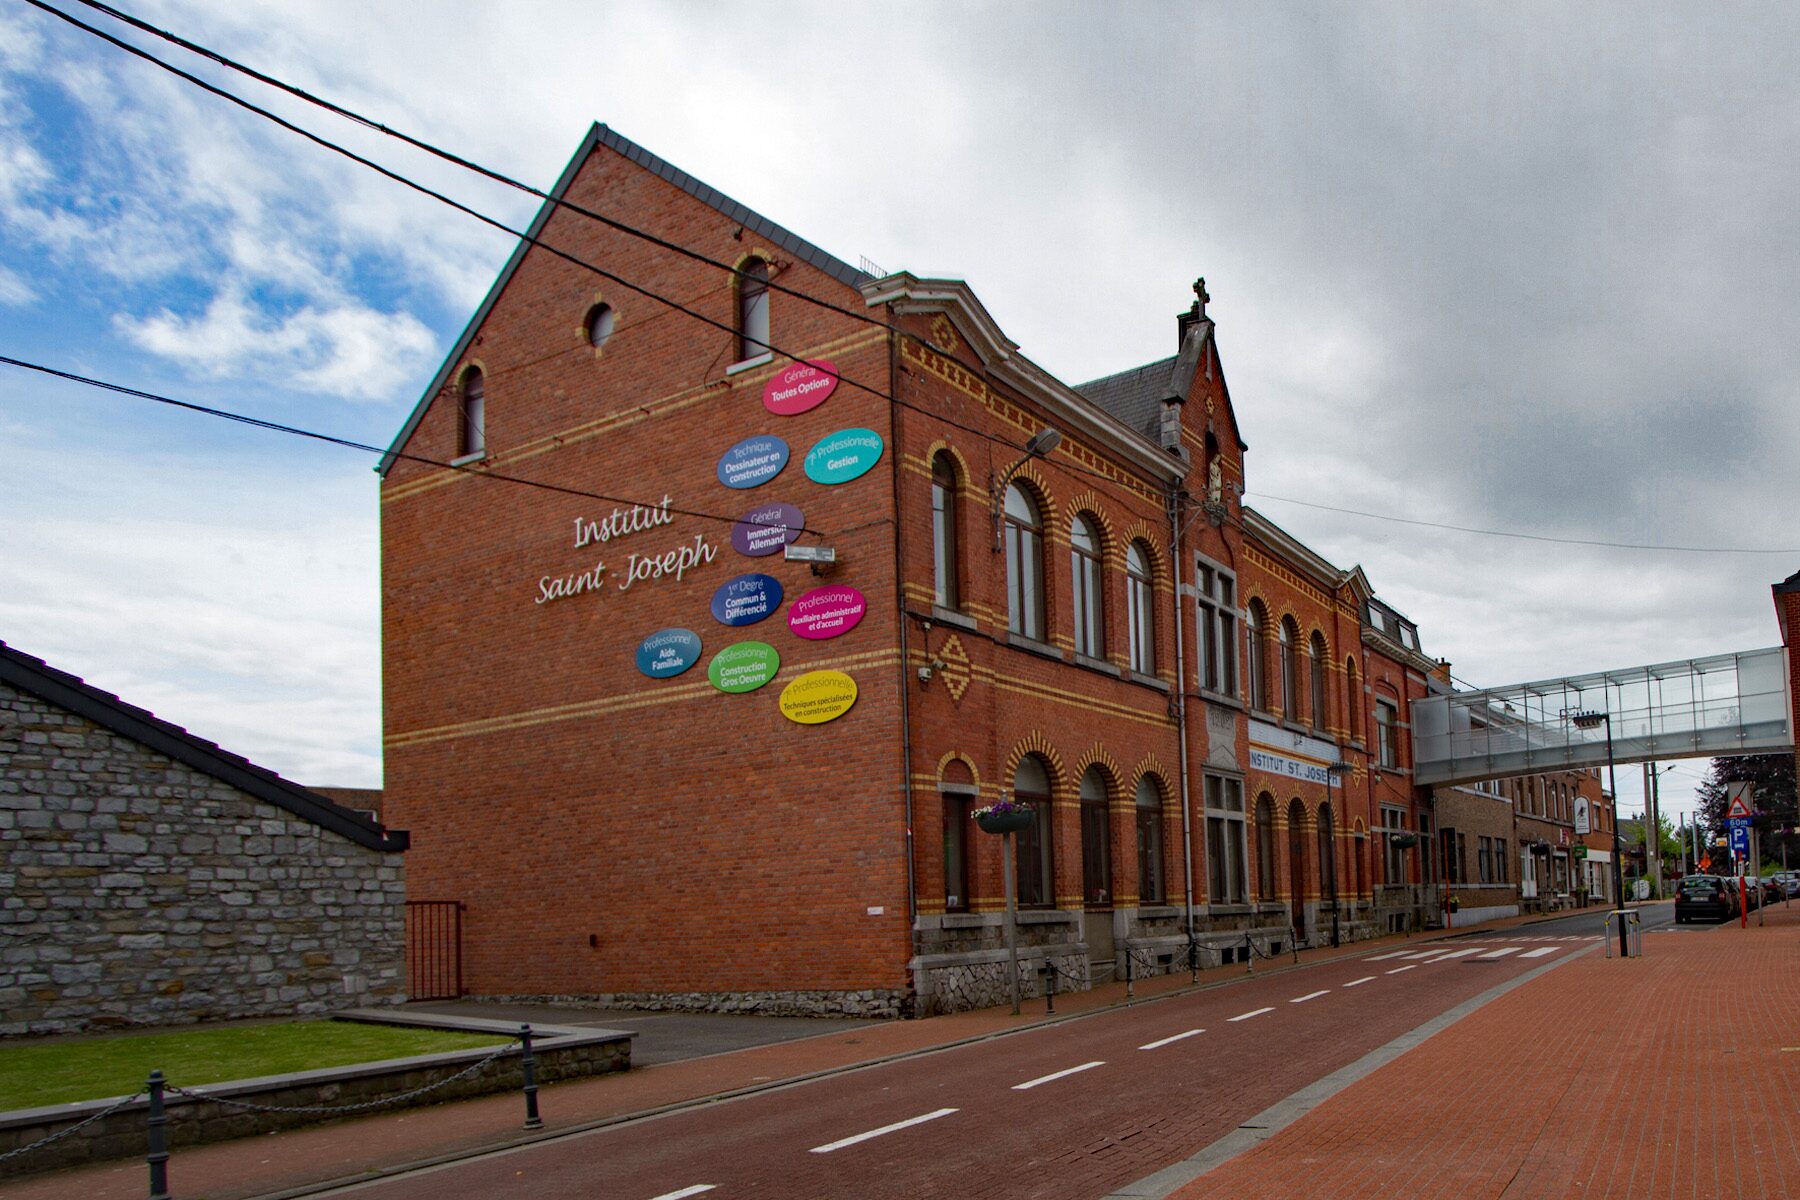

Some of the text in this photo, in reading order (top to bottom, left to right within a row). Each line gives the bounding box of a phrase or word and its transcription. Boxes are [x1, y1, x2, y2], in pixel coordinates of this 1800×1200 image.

[784, 367, 816, 384] Général
[771, 377, 830, 402] Toutes Options
[733, 441, 772, 459] Technique
[817, 436, 879, 460] Professionnelle
[725, 451, 780, 474] Dessinateur en
[827, 455, 859, 471] Gestion
[729, 463, 776, 484] construction
[574, 494, 673, 548] Institut
[751, 508, 782, 524] Général
[747, 523, 787, 541] Immersion
[749, 533, 785, 551] Allemand
[535, 561, 606, 604] Saint
[619, 534, 718, 590] Joseph
[739, 578, 764, 593] Degré
[725, 591, 767, 609] Commun &
[798, 592, 854, 613] Professionnel
[725, 602, 768, 620] Différencié
[790, 603, 862, 626] Auxiliaire administratif
[808, 616, 844, 631] et d'accueil
[643, 634, 692, 653] Professionnel
[659, 647, 676, 659] Aide
[717, 647, 769, 667] Professionnel
[651, 656, 684, 671] Familiale
[720, 660, 767, 677] Construction
[720, 672, 767, 688] Gros Oeuvre
[783, 700, 817, 711] Techniques
[803, 704, 842, 717] construction
[1287, 761, 1302, 776] ST.
[1733, 828, 1744, 841] P
